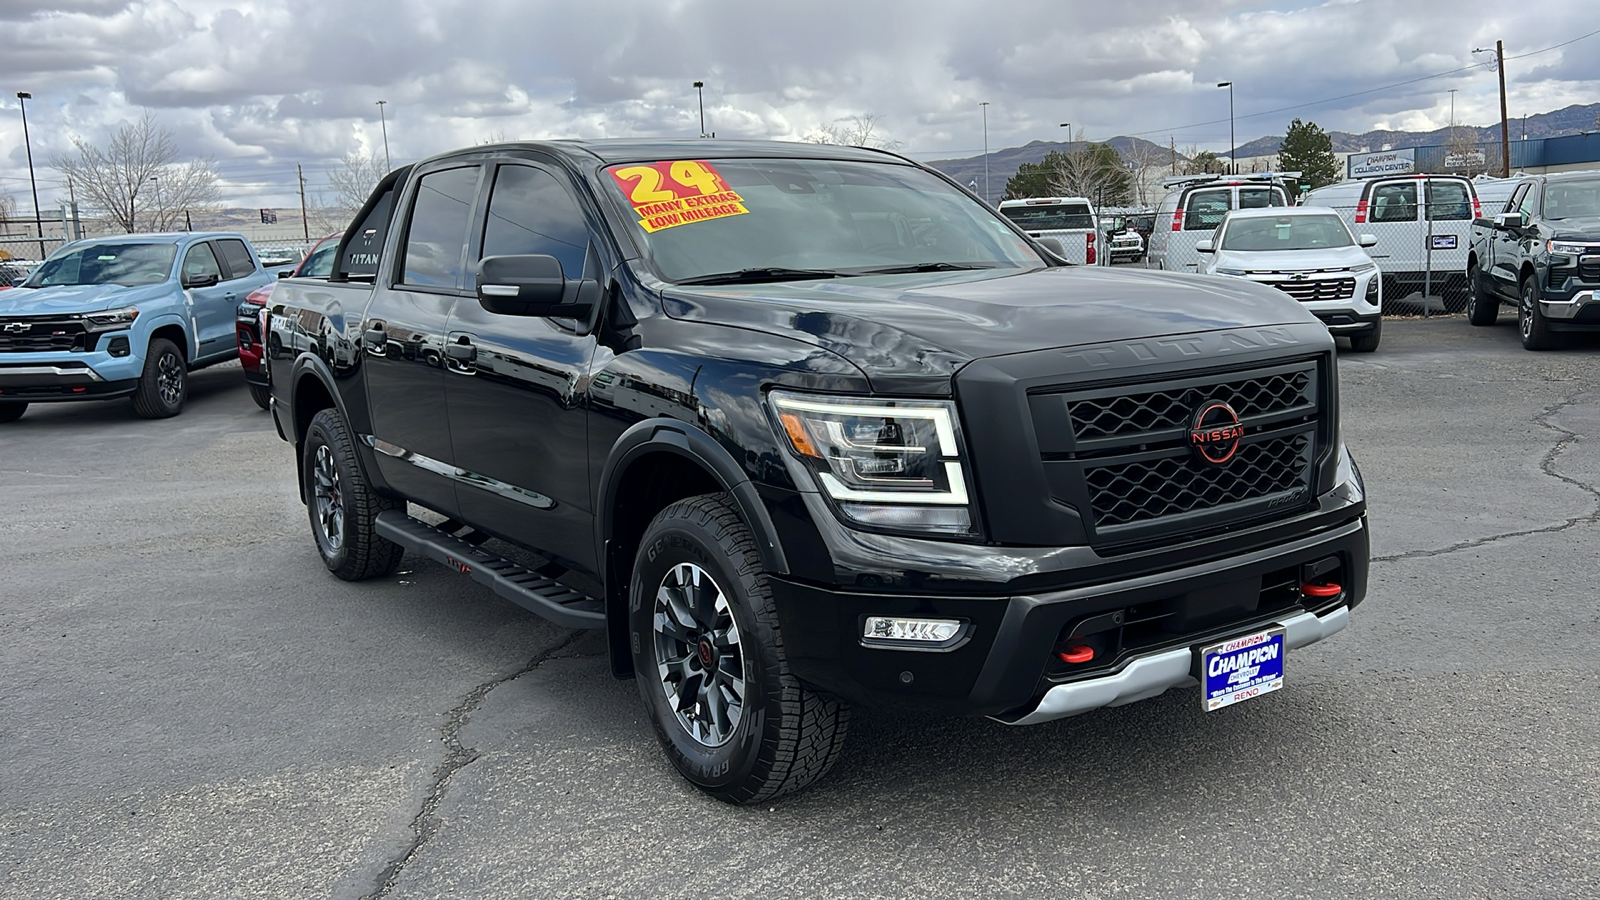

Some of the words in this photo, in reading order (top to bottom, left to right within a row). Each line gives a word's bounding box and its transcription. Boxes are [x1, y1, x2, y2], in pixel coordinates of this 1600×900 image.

[1354, 165, 1384, 173] COLLISION
[1385, 163, 1410, 171] CENTER
[1366, 153, 1397, 165] CHAMPION
[615, 160, 722, 204] 24
[638, 200, 682, 217] MANY
[686, 192, 741, 208] EXTRAS
[647, 213, 681, 229] LOW
[681, 204, 741, 222] MILEAGE
[350, 254, 379, 264] TITAN
[1062, 327, 1299, 367] TITAN
[1192, 425, 1245, 444] NISSAN
[1225, 634, 1265, 652] CHAMPION
[1208, 643, 1279, 677] CHAMPION
[1230, 668, 1258, 681] CHEVROLET
[1234, 688, 1259, 701] RENO
